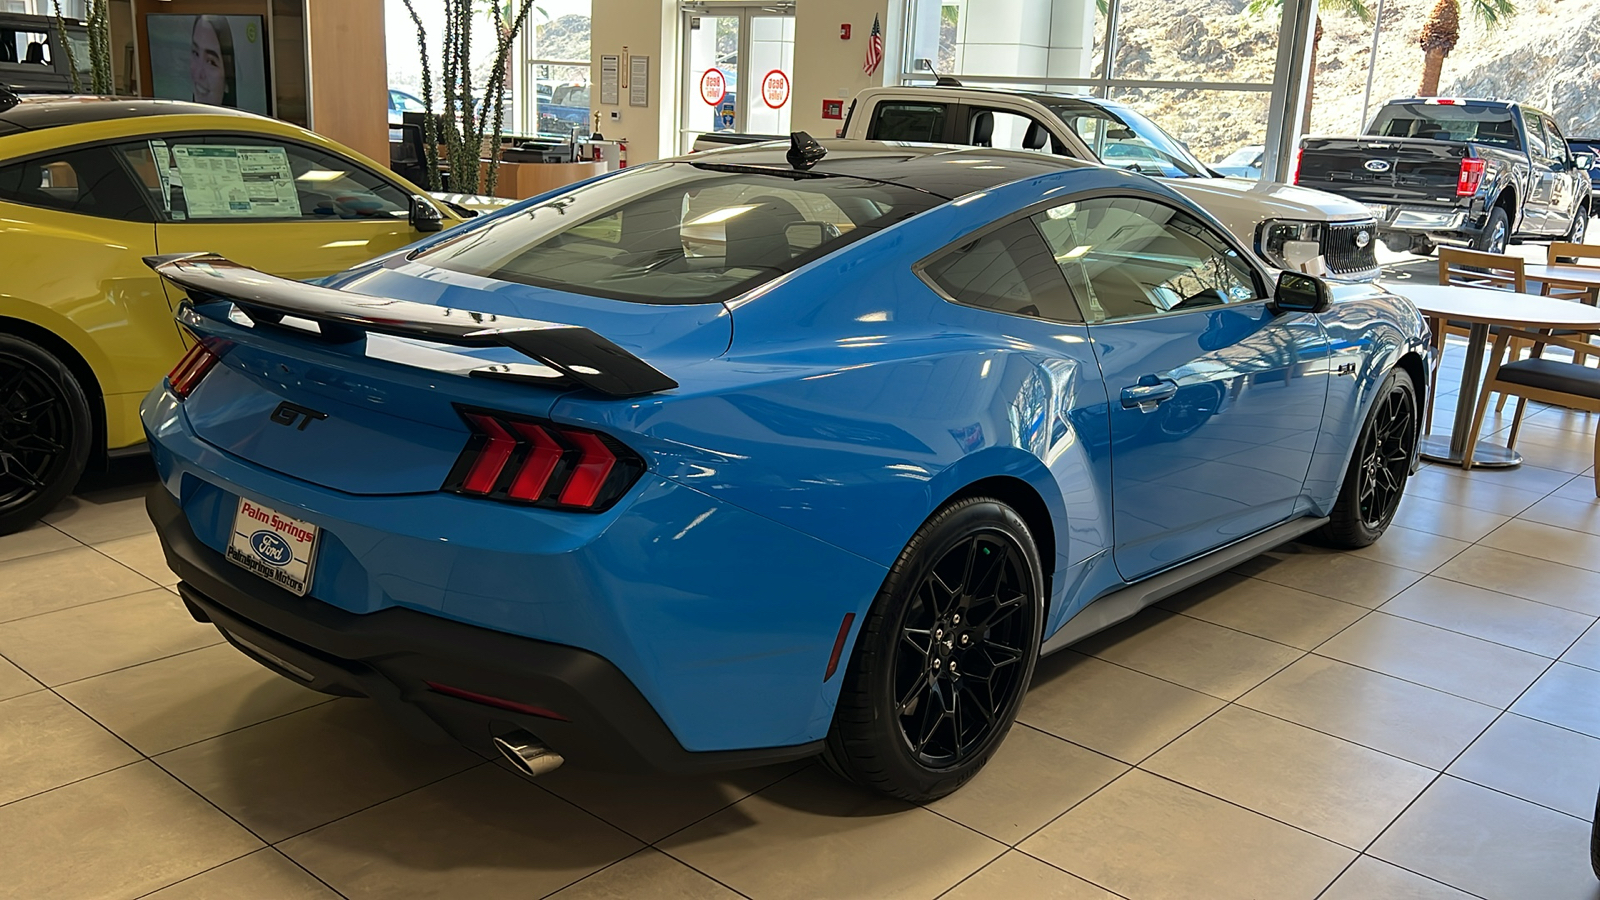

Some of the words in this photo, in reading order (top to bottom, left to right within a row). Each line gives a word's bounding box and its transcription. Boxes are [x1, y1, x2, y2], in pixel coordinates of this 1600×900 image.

[271, 400, 329, 431] GT
[241, 502, 270, 524] Palm
[270, 514, 314, 543] Springs
[259, 535, 284, 561] Ford
[275, 568, 304, 592] Motors
